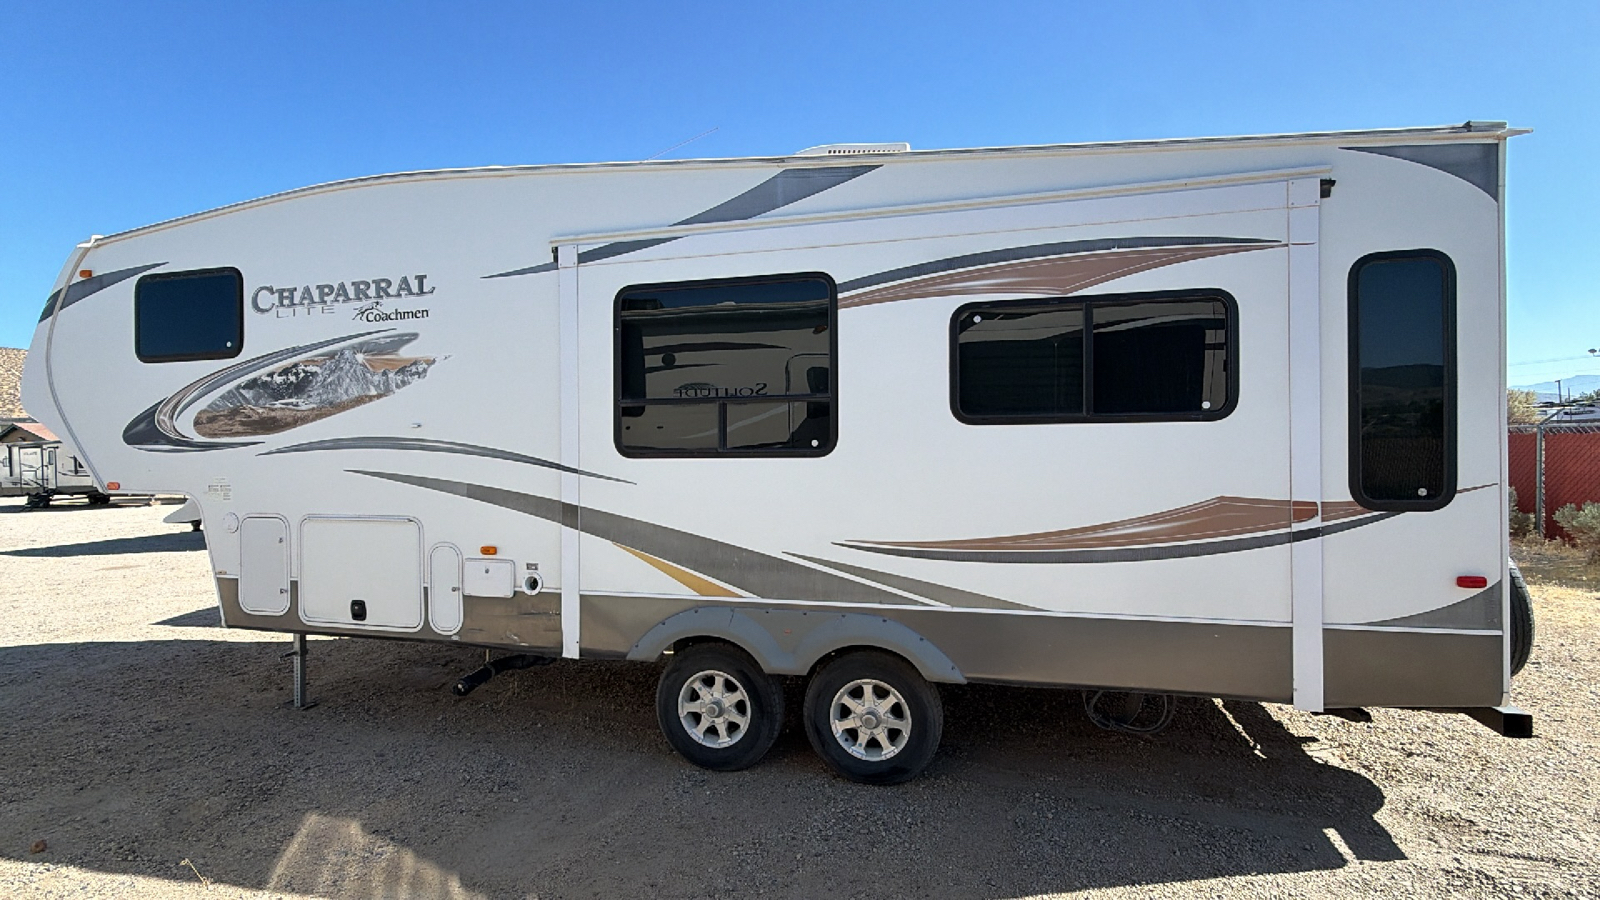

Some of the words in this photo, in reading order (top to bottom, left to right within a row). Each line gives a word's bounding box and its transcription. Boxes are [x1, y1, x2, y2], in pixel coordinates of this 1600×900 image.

[251, 274, 436, 315] CHAPARRAL
[276, 304, 335, 319] LITE
[365, 308, 430, 323] Coachmen
